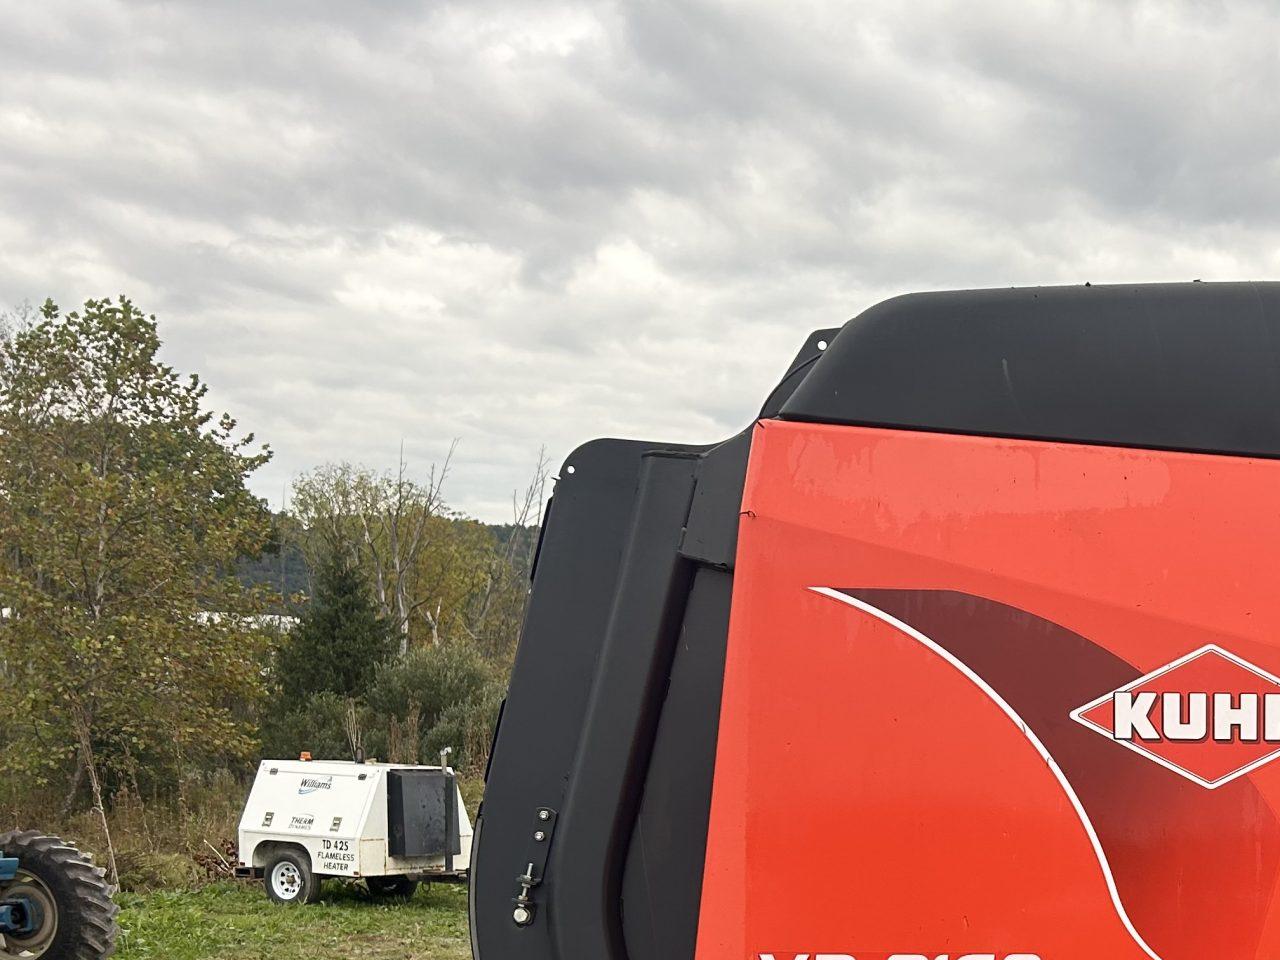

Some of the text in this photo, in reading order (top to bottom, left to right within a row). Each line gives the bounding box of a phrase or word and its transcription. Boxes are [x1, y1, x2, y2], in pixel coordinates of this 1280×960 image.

[300, 778, 332, 790] Williams
[322, 839, 349, 851] TD 425
[317, 851, 355, 862] FLAMELESS
[323, 862, 349, 871] HEATER
